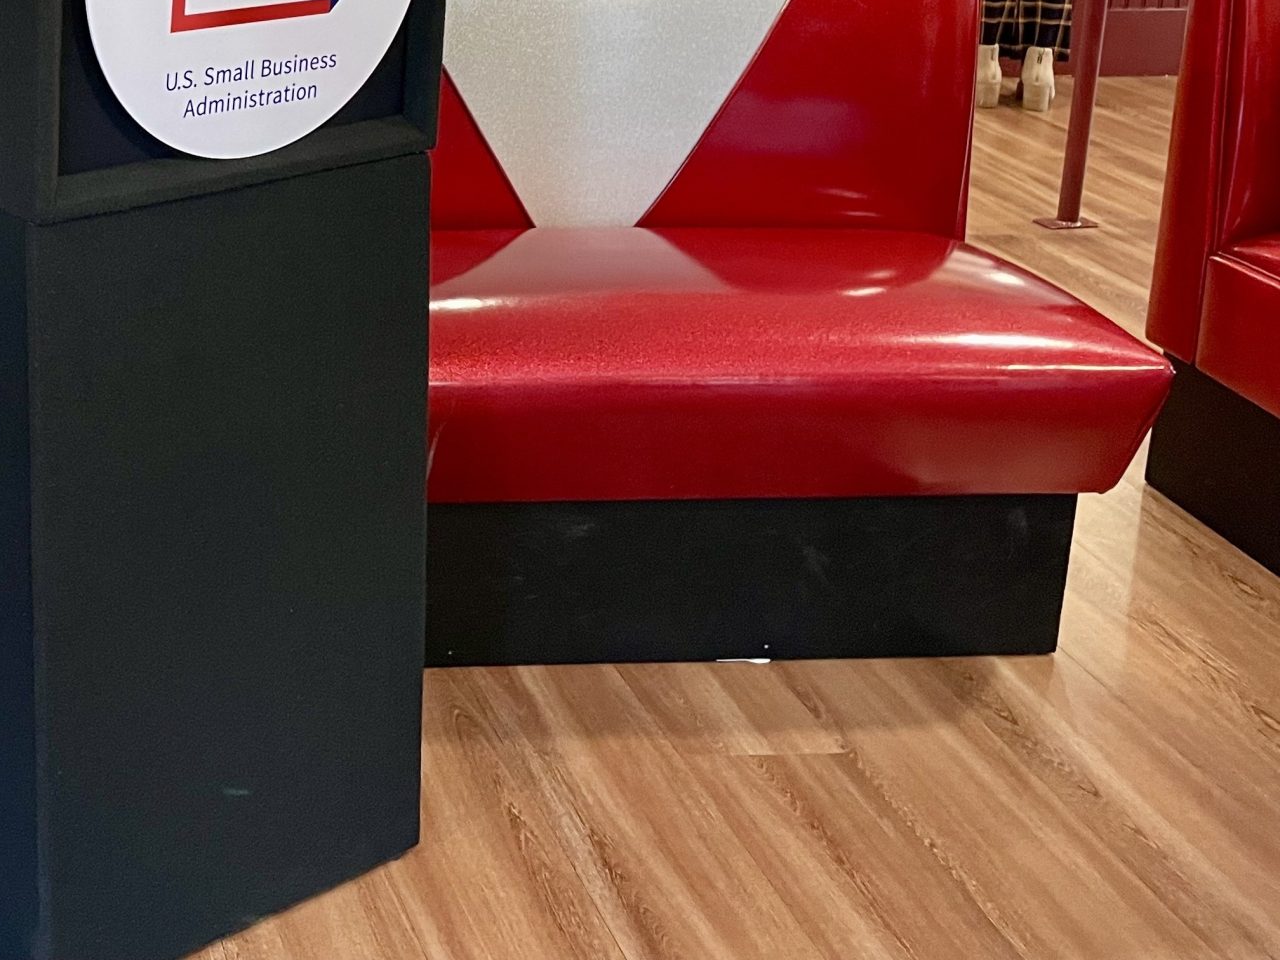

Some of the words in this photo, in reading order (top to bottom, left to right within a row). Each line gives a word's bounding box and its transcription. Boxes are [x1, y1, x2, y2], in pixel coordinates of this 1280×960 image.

[165, 69, 197, 92] U.S.
[204, 59, 255, 86] Small
[261, 52, 337, 79] Business
[183, 82, 318, 119] Administration
